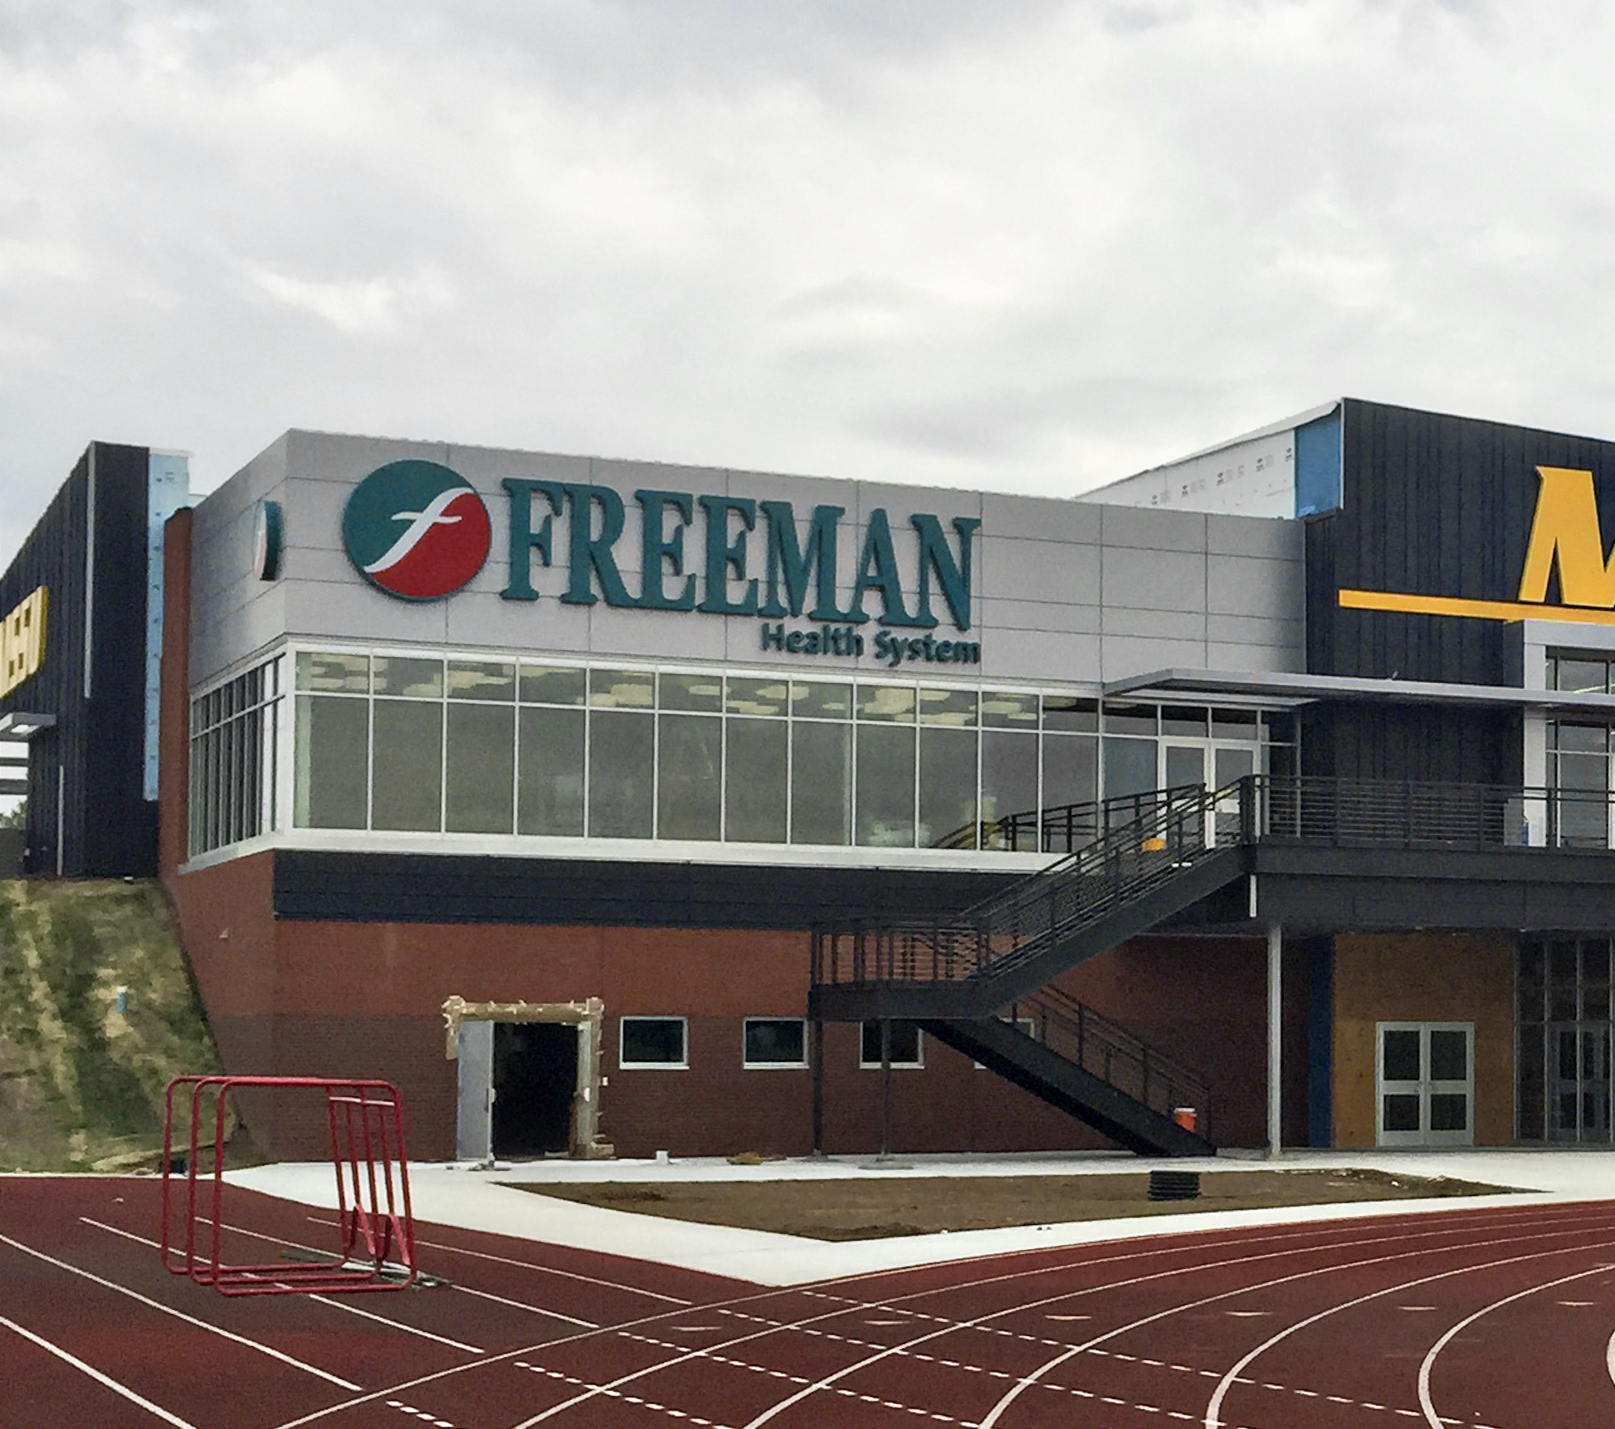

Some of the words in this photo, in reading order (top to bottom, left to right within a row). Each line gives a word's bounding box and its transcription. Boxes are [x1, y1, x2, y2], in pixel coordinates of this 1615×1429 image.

[500, 477, 982, 632] FREEMAN
[761, 622, 864, 657] Health
[874, 630, 981, 667] System
